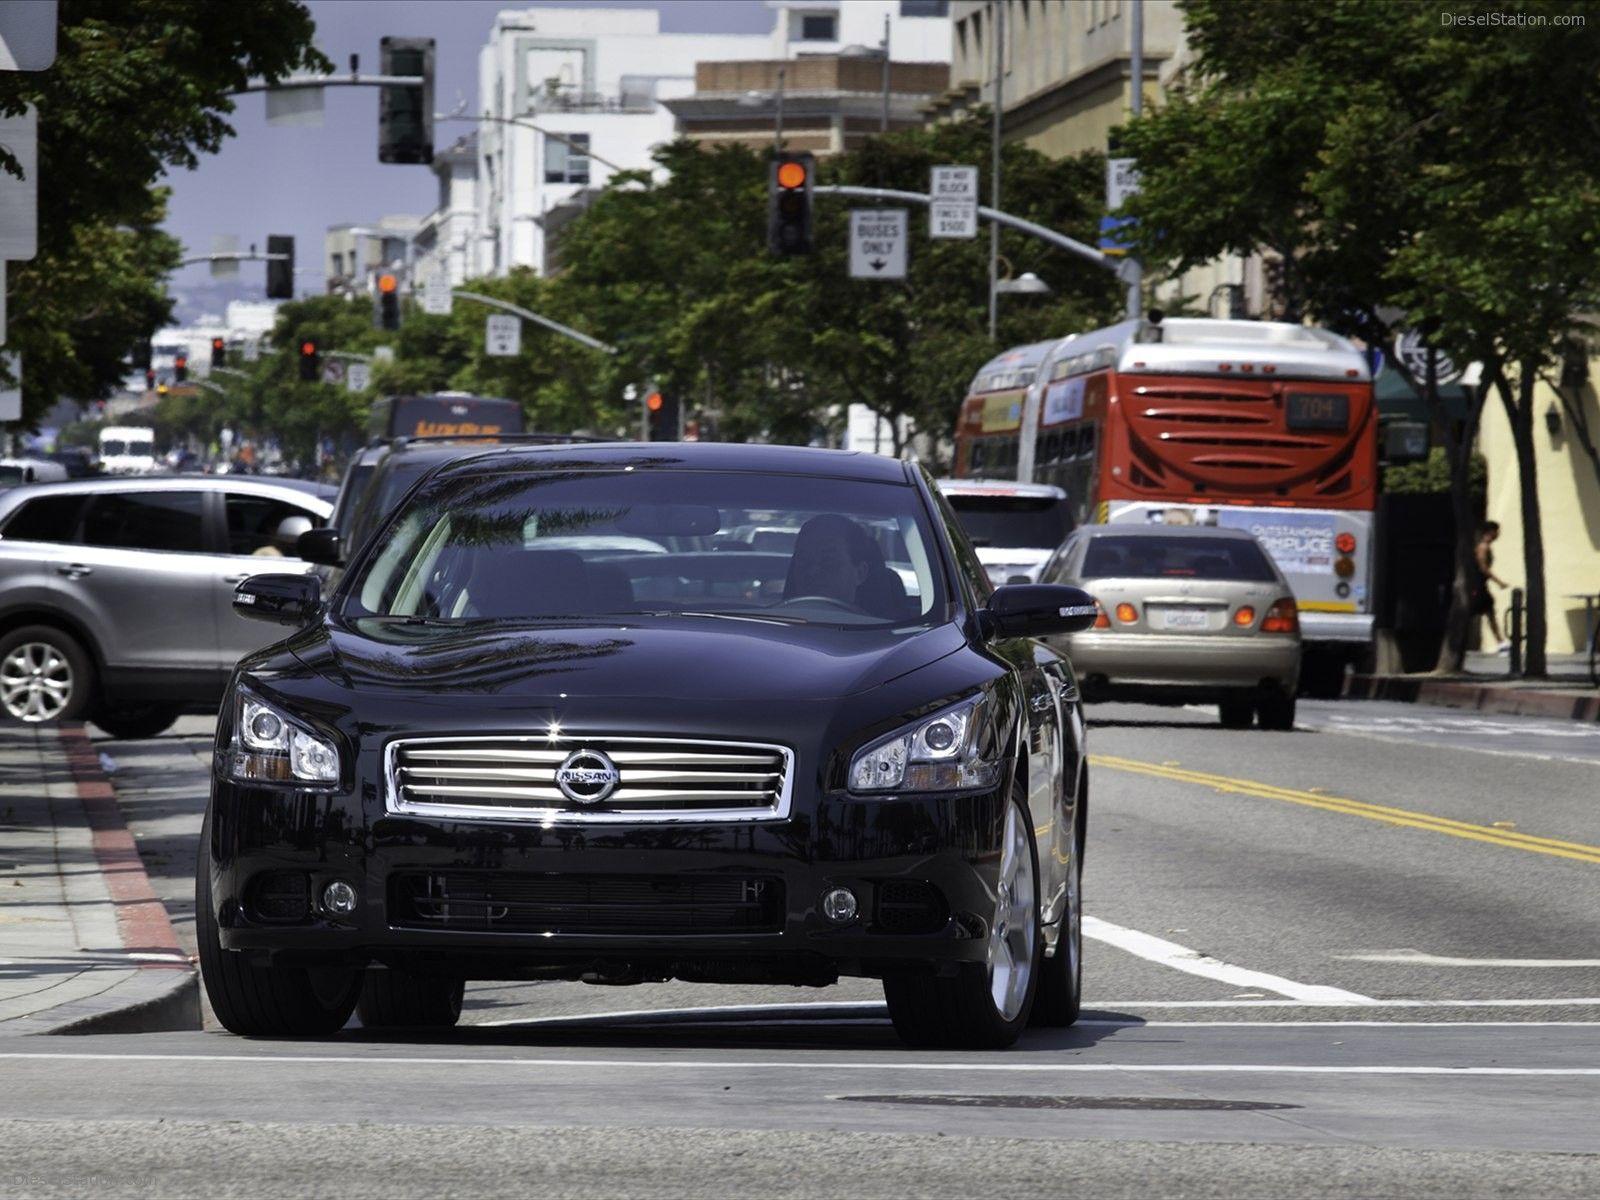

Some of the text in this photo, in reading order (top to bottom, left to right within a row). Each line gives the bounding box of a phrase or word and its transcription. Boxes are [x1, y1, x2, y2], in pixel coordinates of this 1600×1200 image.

[938, 183, 969, 193] BLOCK
[857, 224, 899, 237] BUSES
[861, 241, 894, 255] ONLY
[1258, 536, 1332, 552] OMPLICE
[561, 770, 612, 781] NISSAN
